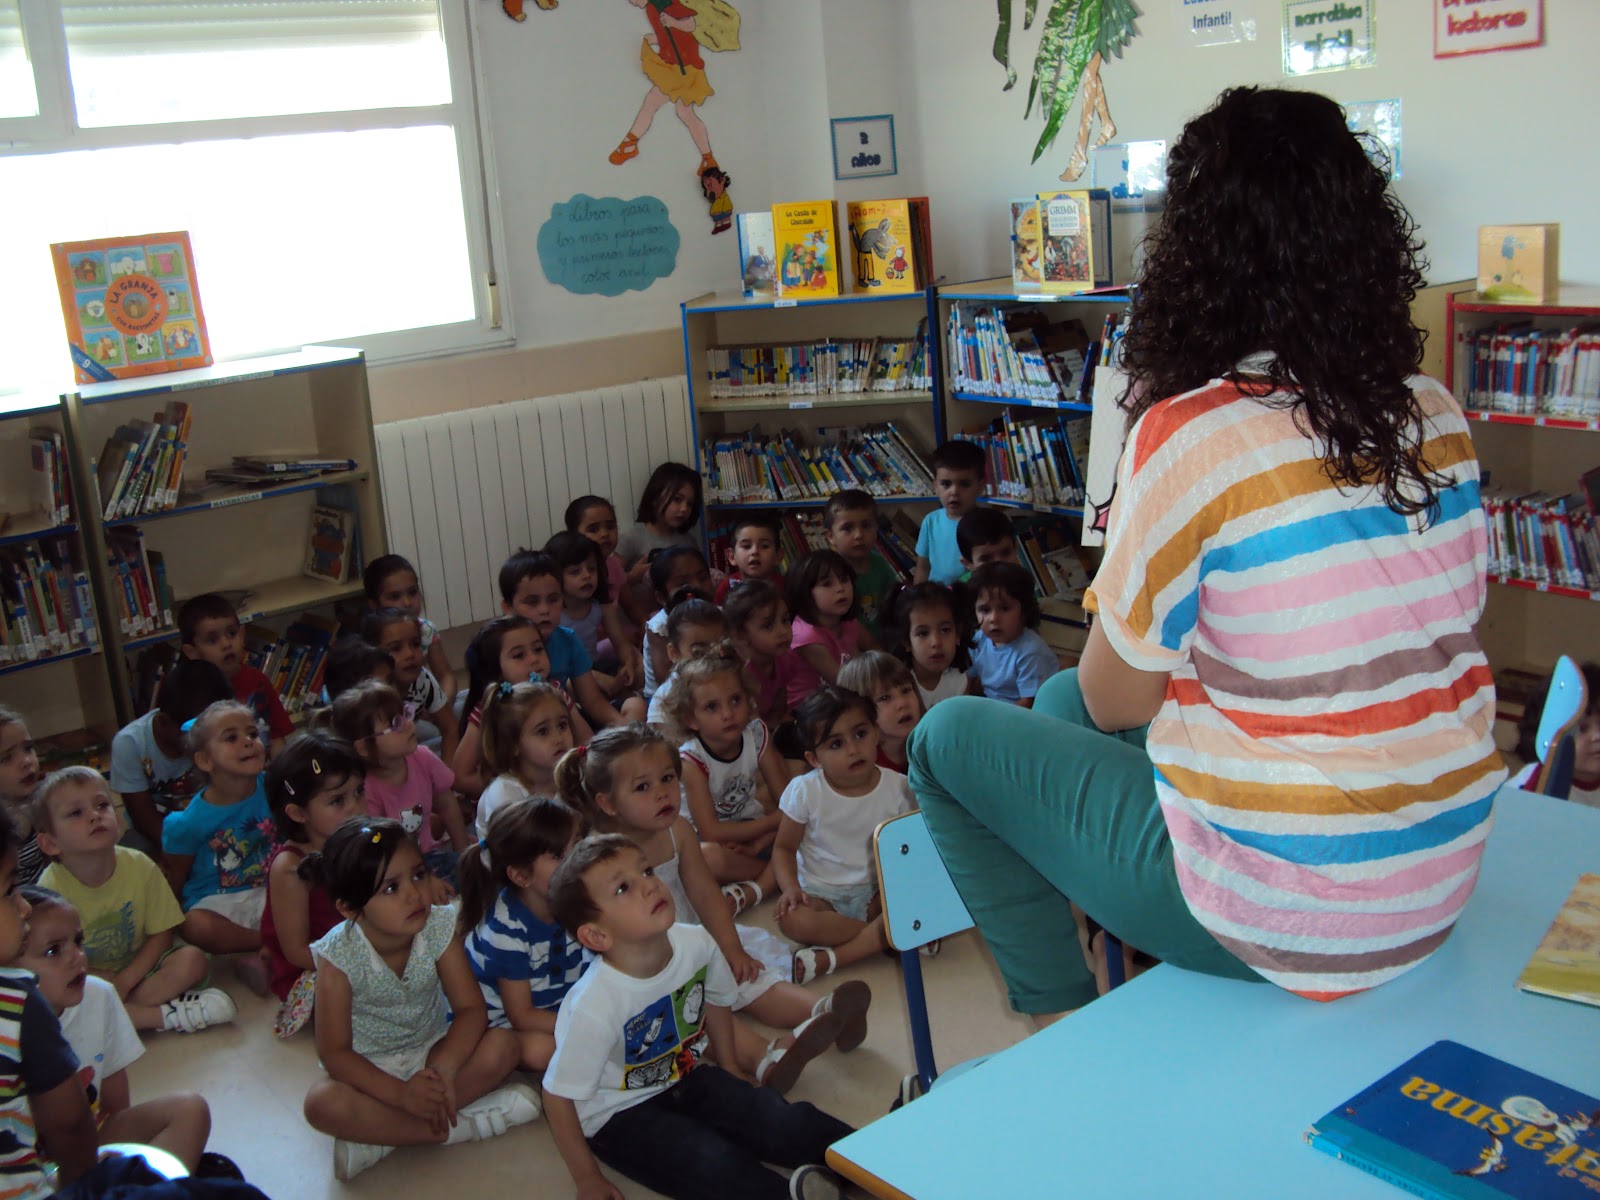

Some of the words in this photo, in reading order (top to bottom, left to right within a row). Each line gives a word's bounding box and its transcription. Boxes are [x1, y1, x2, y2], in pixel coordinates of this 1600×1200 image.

[1192, 10, 1231, 29] Infantil
[1294, 2, 1362, 27] narrativa
[569, 202, 613, 222] Libros
[620, 203, 650, 225] para
[1049, 206, 1077, 215] GRIMM
[557, 231, 575, 248] los
[109, 291, 121, 304] LA
[119, 280, 158, 299] GRANJA
[82, 359, 91, 369] 9
